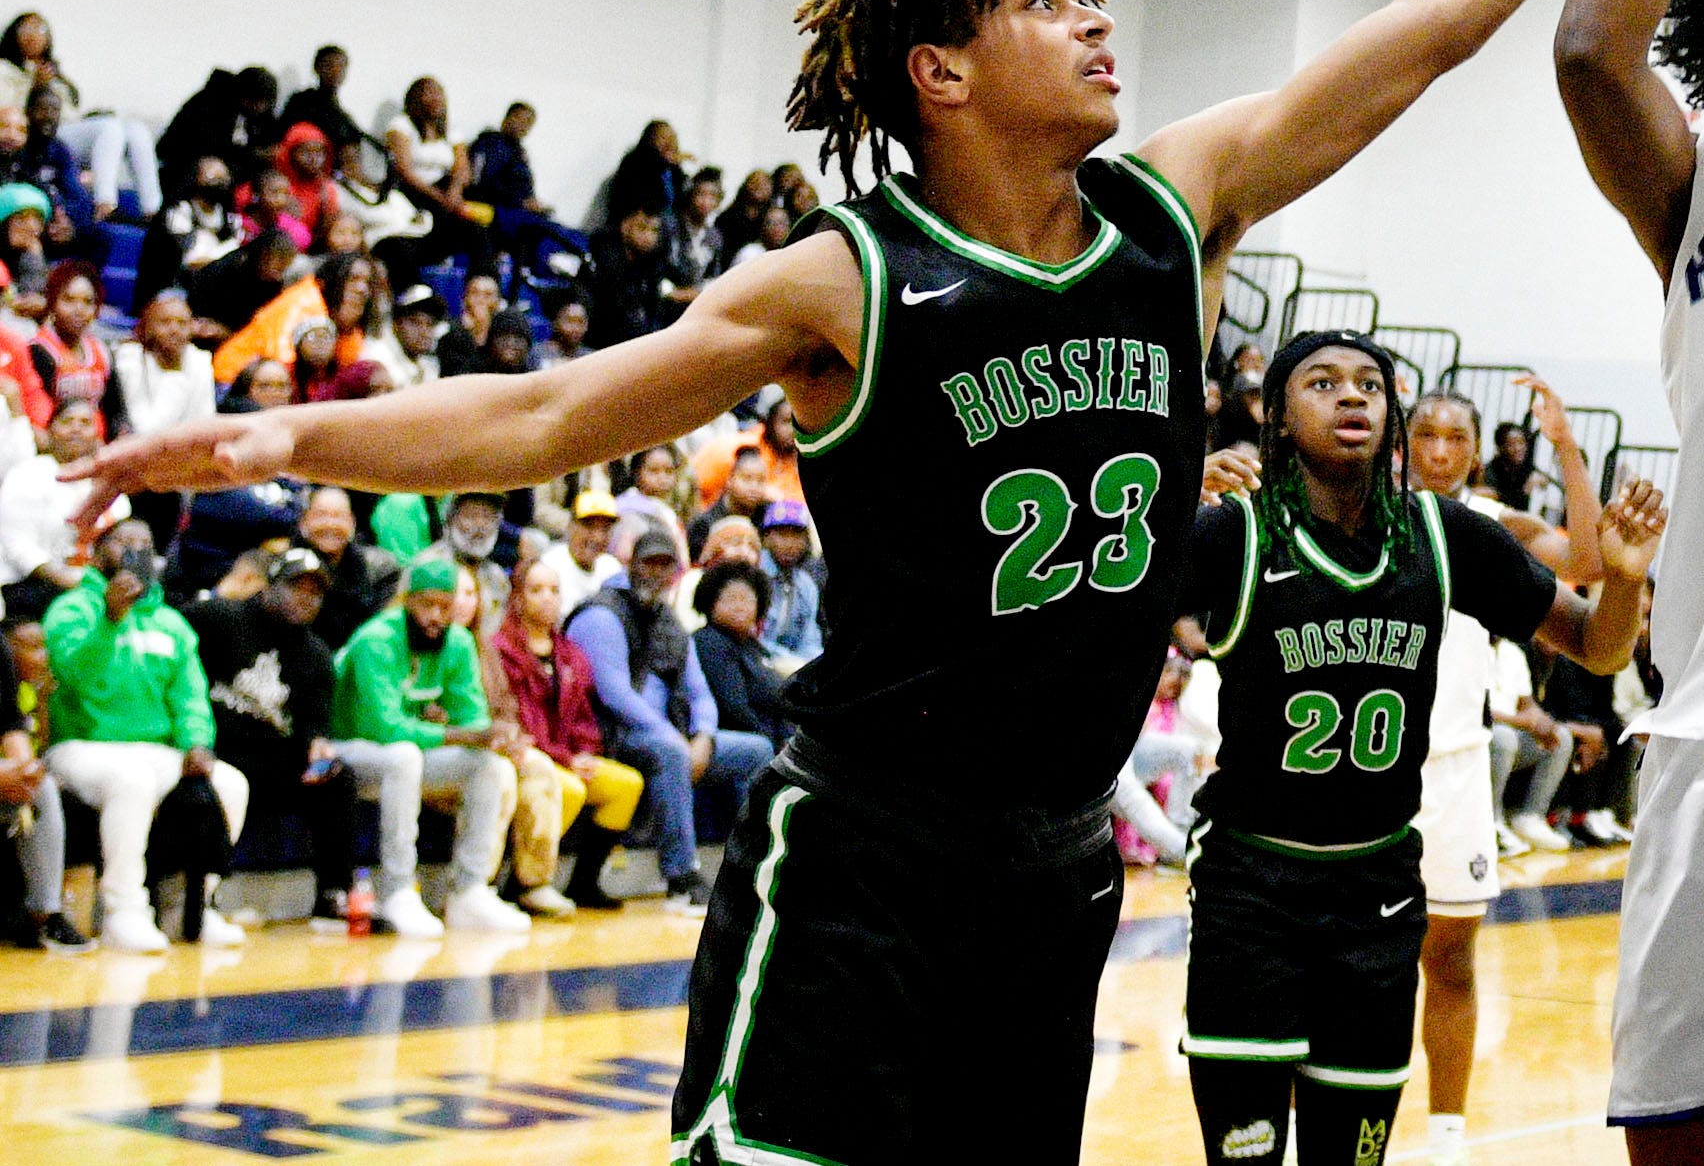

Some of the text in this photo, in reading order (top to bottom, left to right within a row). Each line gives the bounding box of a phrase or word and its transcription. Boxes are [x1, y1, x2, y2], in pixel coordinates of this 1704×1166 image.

[940, 337, 1169, 447] BOSSIER
[980, 452, 1162, 617] 23
[1276, 618, 1426, 674] BOSSIER
[1281, 689, 1406, 774] 20
